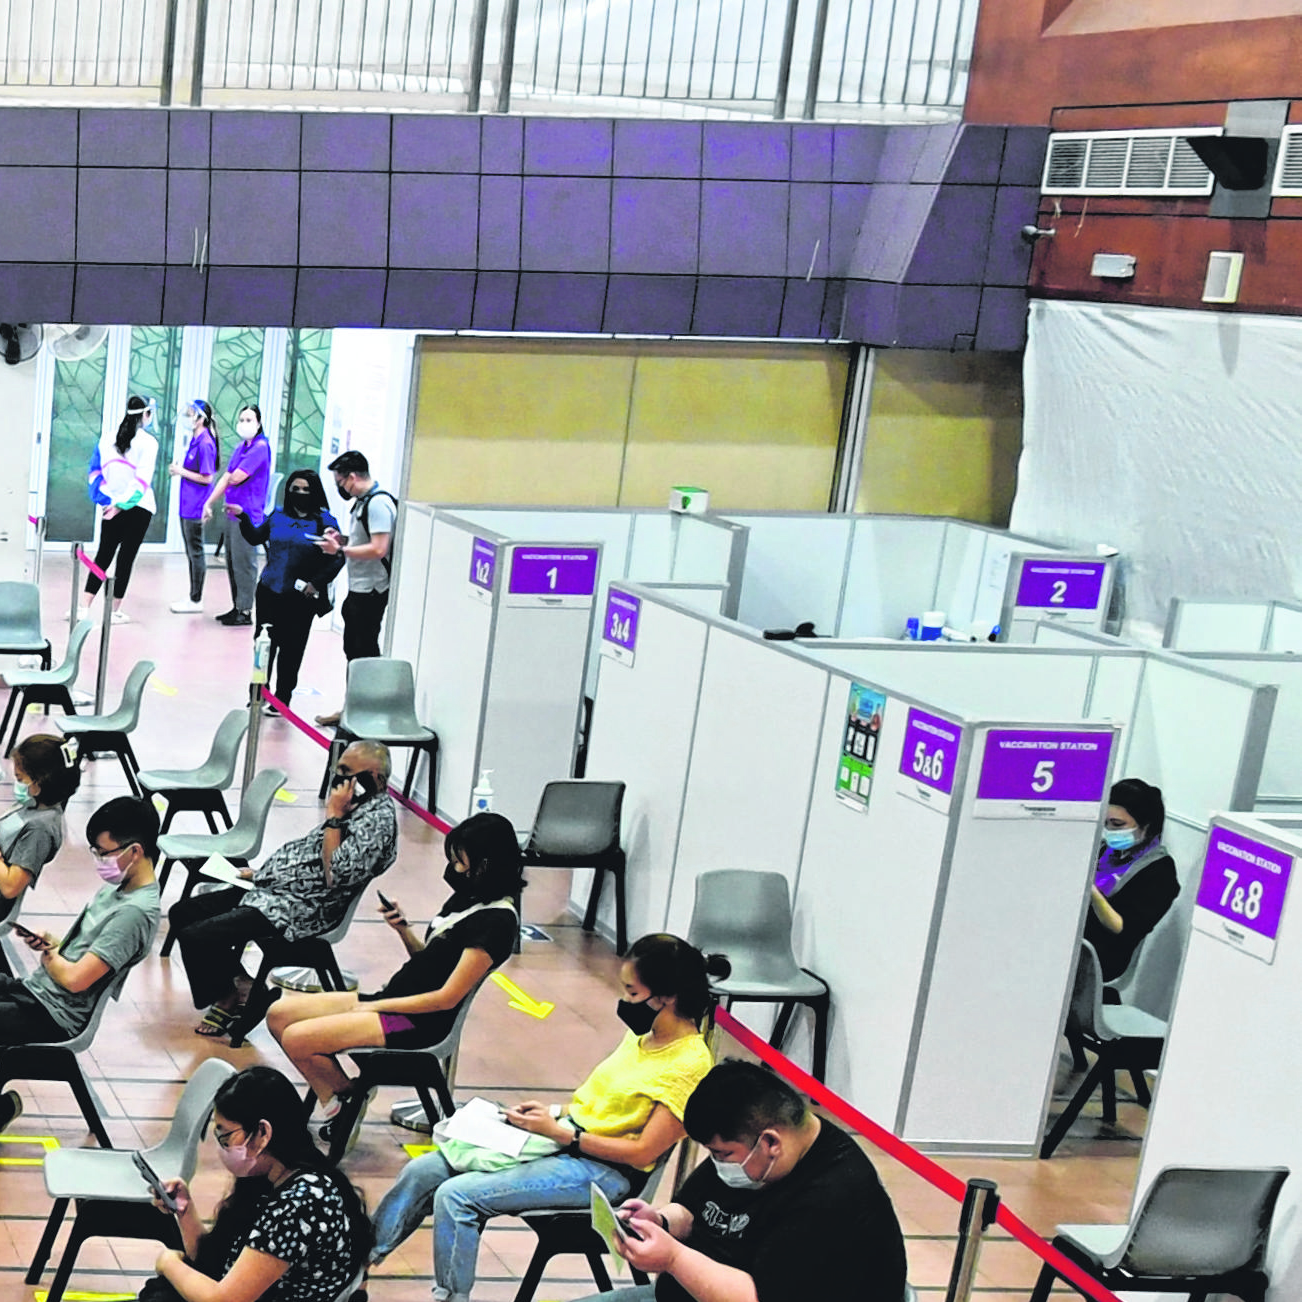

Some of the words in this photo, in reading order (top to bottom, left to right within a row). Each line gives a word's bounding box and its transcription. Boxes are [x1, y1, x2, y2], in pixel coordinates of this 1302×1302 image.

[546, 567, 558, 589] 1
[1049, 581, 1067, 603] 2
[1060, 742, 1098, 750] STATION
[912, 741, 944, 781] 5&6
[1031, 760, 1055, 793] 5
[1220, 868, 1264, 920] 7&8
